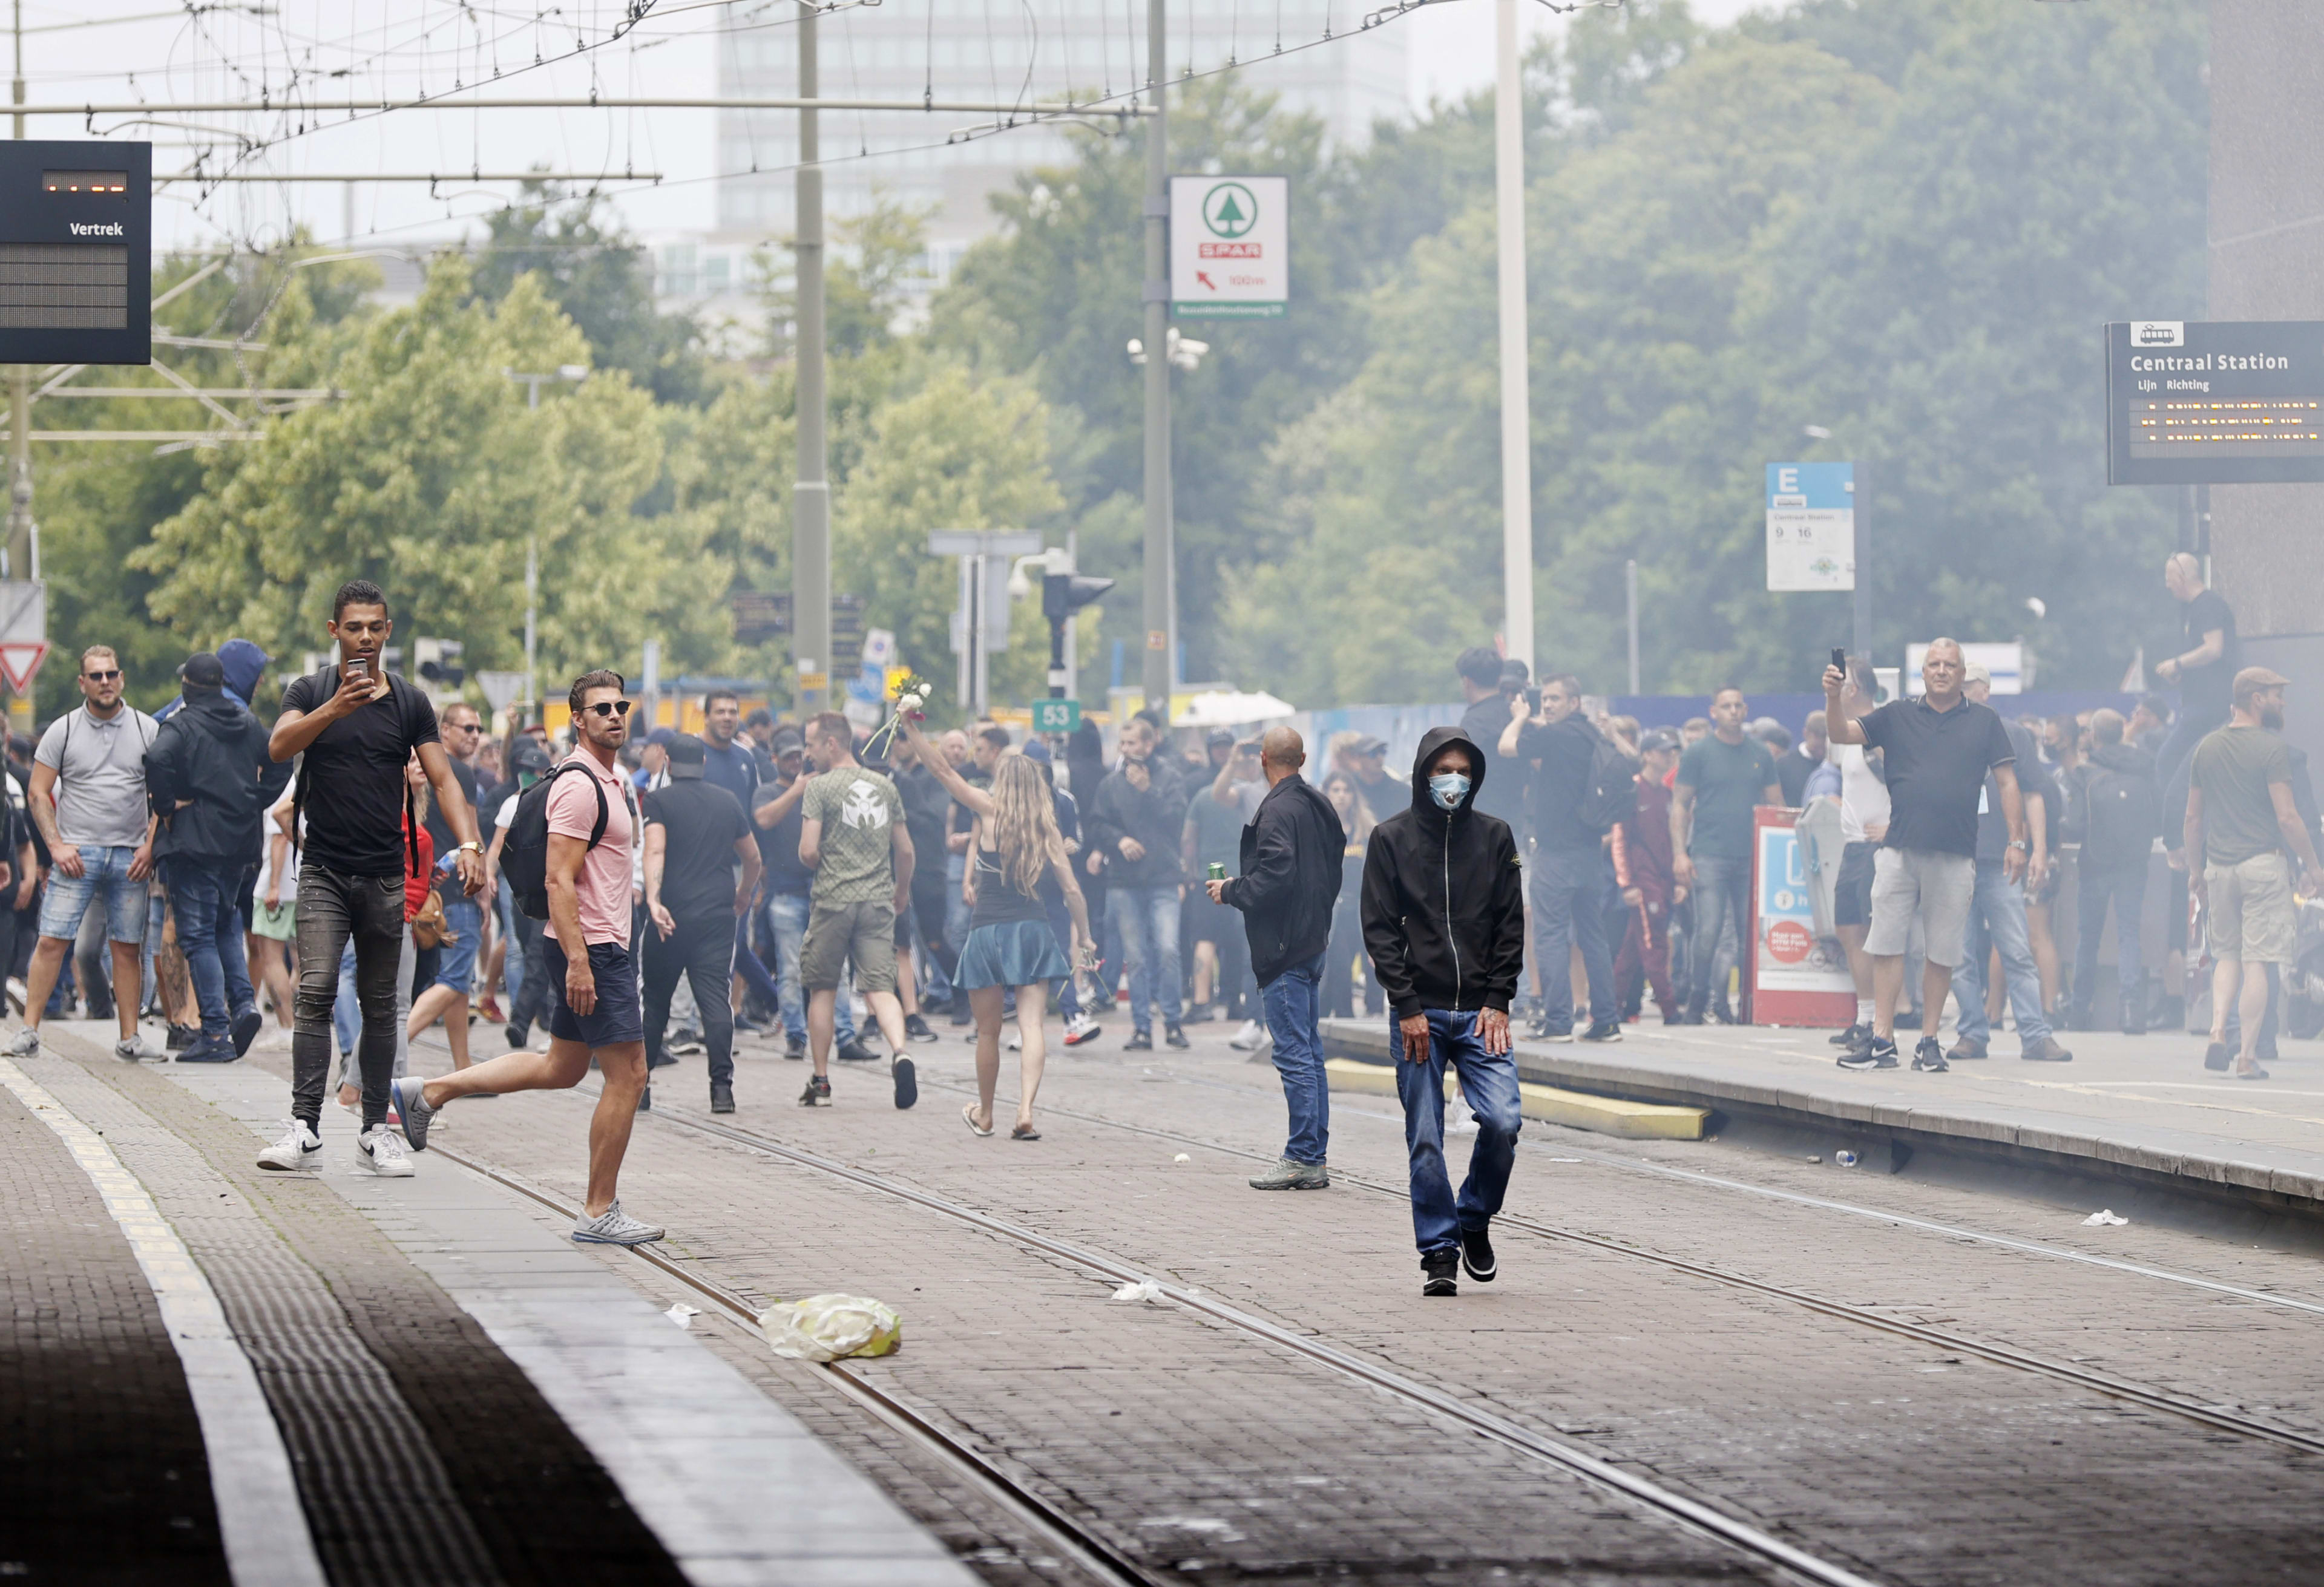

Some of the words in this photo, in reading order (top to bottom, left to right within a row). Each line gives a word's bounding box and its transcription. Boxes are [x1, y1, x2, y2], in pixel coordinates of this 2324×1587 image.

[70, 222, 123, 236] Vertrek
[1202, 244, 1260, 257] SPAR
[2130, 353, 2211, 372] Centraal
[2217, 352, 2289, 370] Station
[2138, 379, 2157, 392] Lijn
[2166, 379, 2210, 392] Richting
[1779, 468, 1799, 492] E
[1776, 526, 1784, 538] 9
[1797, 526, 1812, 538] 16
[1043, 704, 1070, 725] 53
